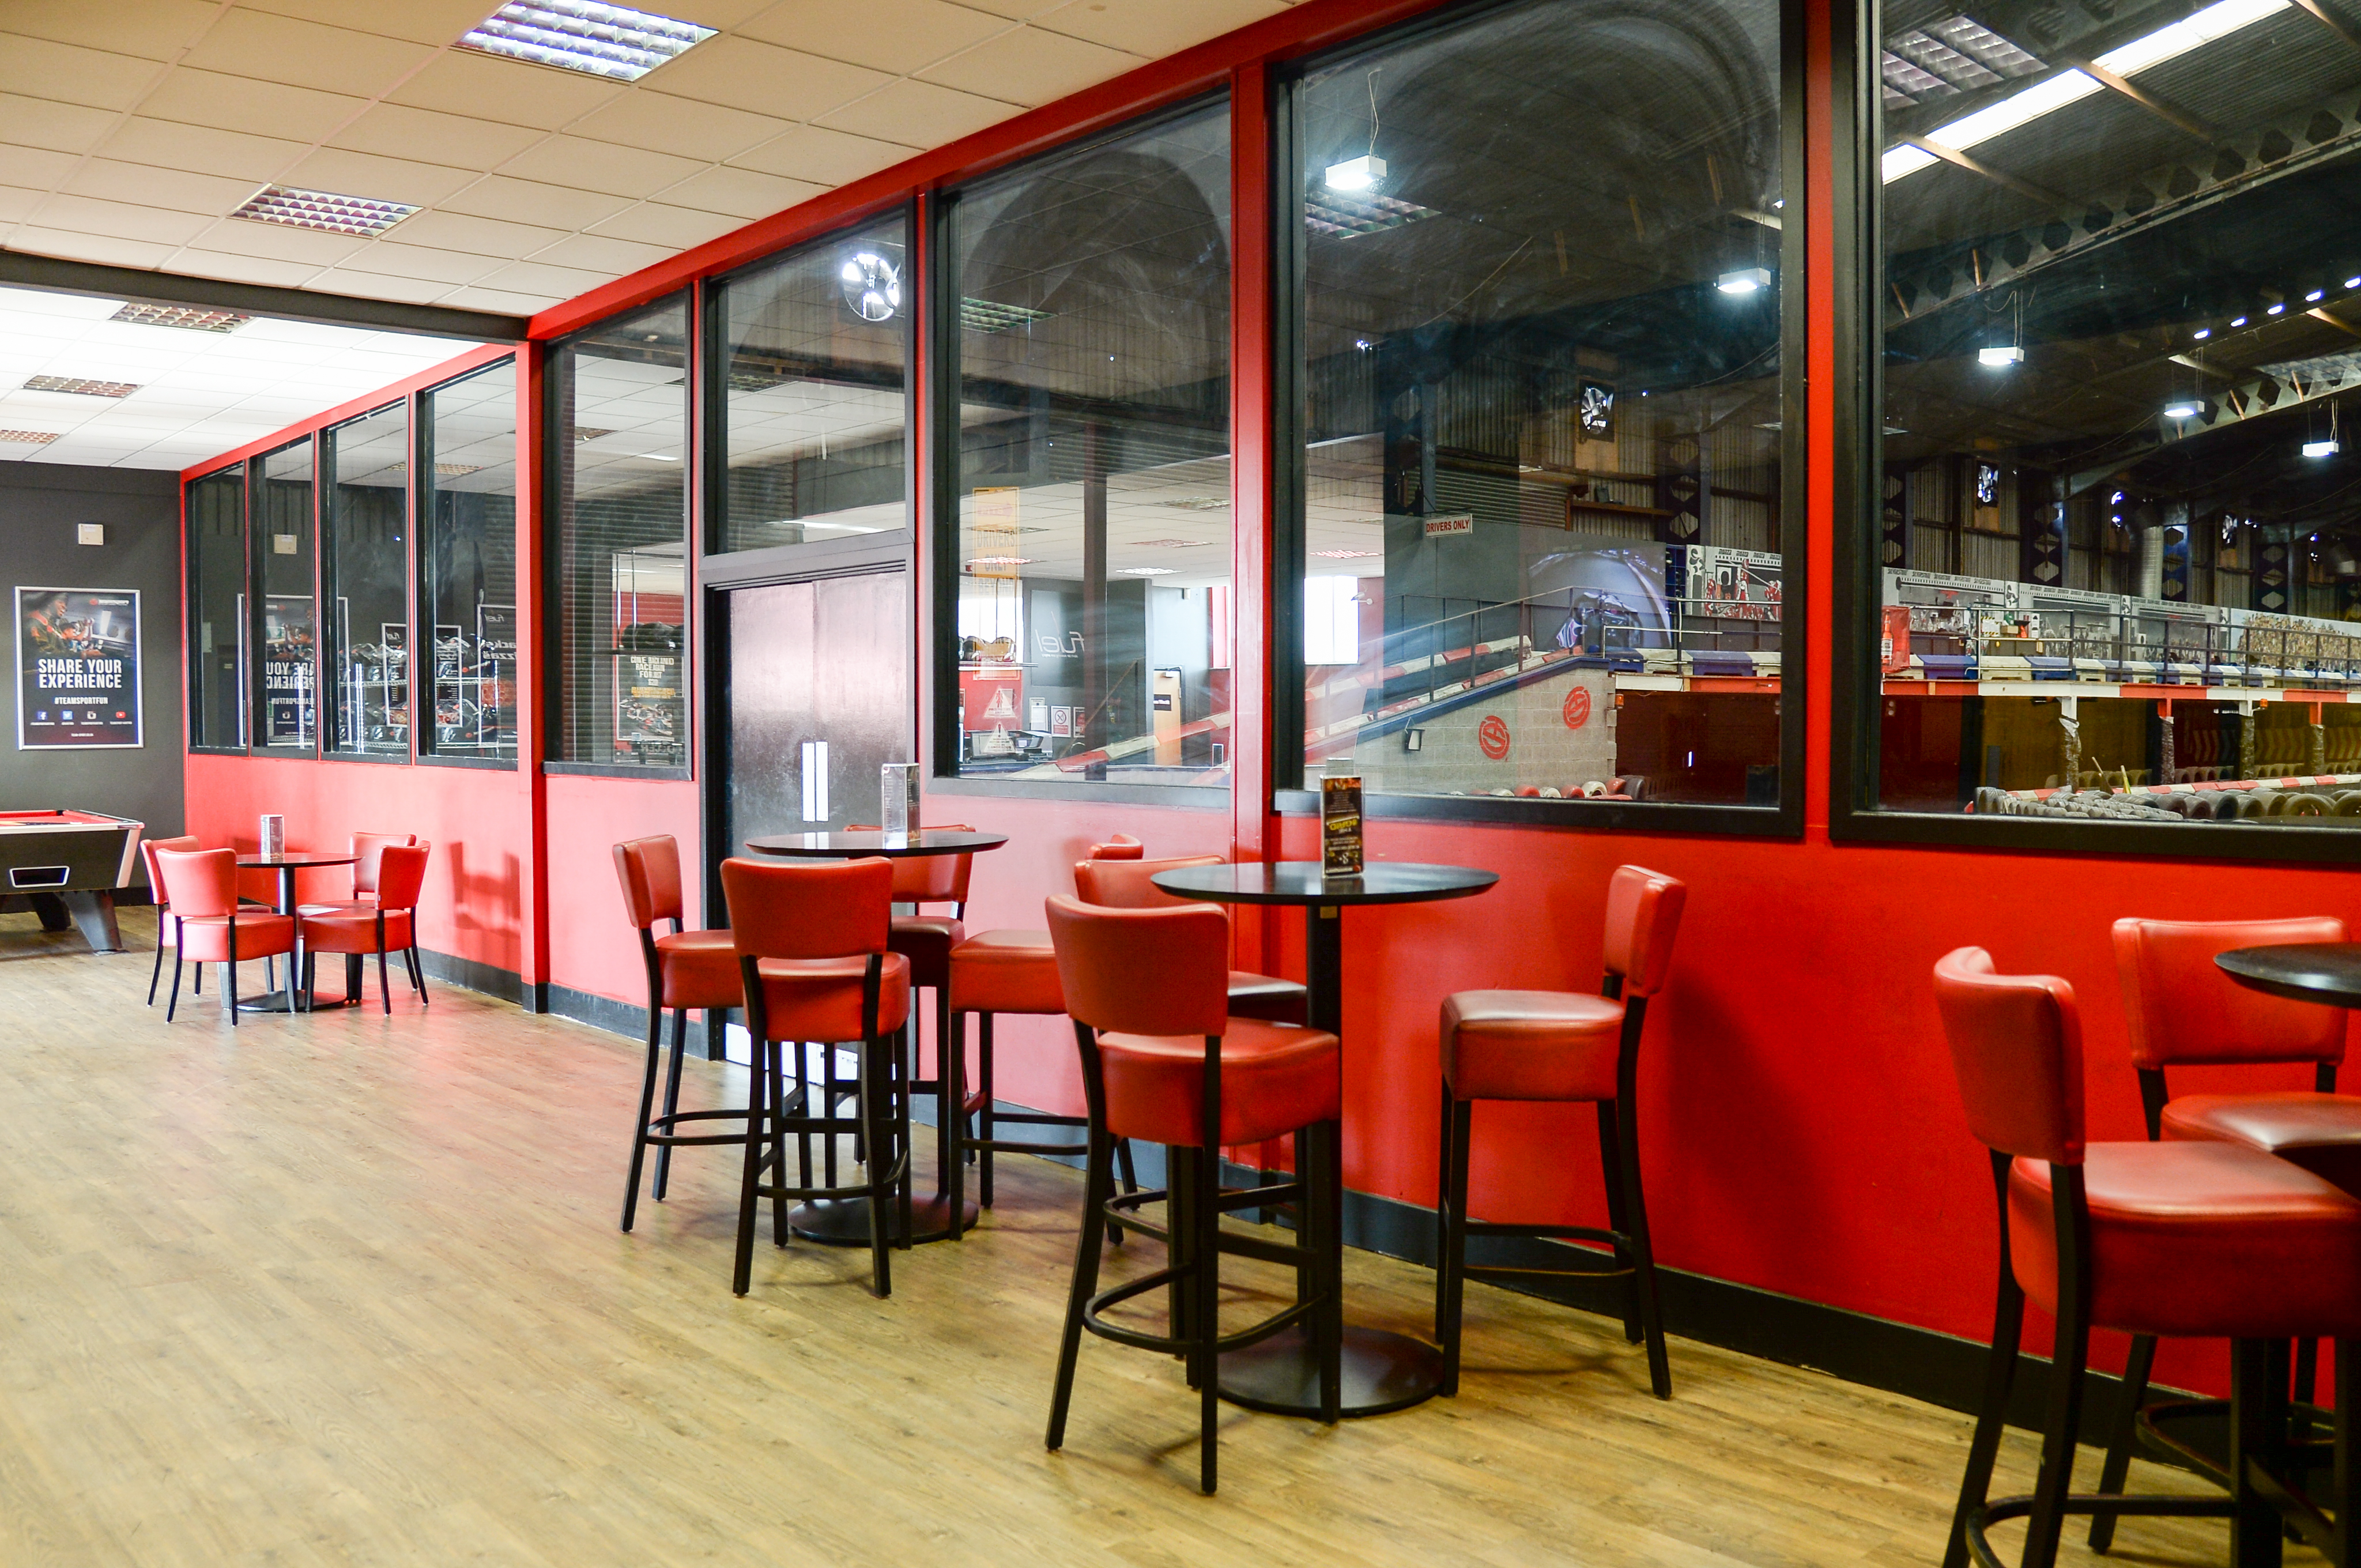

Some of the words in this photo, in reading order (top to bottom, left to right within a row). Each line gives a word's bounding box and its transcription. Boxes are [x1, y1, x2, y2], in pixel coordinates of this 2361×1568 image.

[1426, 521, 1452, 532] DRIVERS
[1453, 519, 1469, 530] ONLY
[977, 530, 1016, 548] DRIVERS
[985, 553, 1008, 572] ONLY
[38, 659, 83, 673] SHARE
[87, 659, 122, 673] YOUR
[39, 674, 122, 688] EXPERIENCE
[54, 696, 108, 704] #TEAMSPORTFUN
